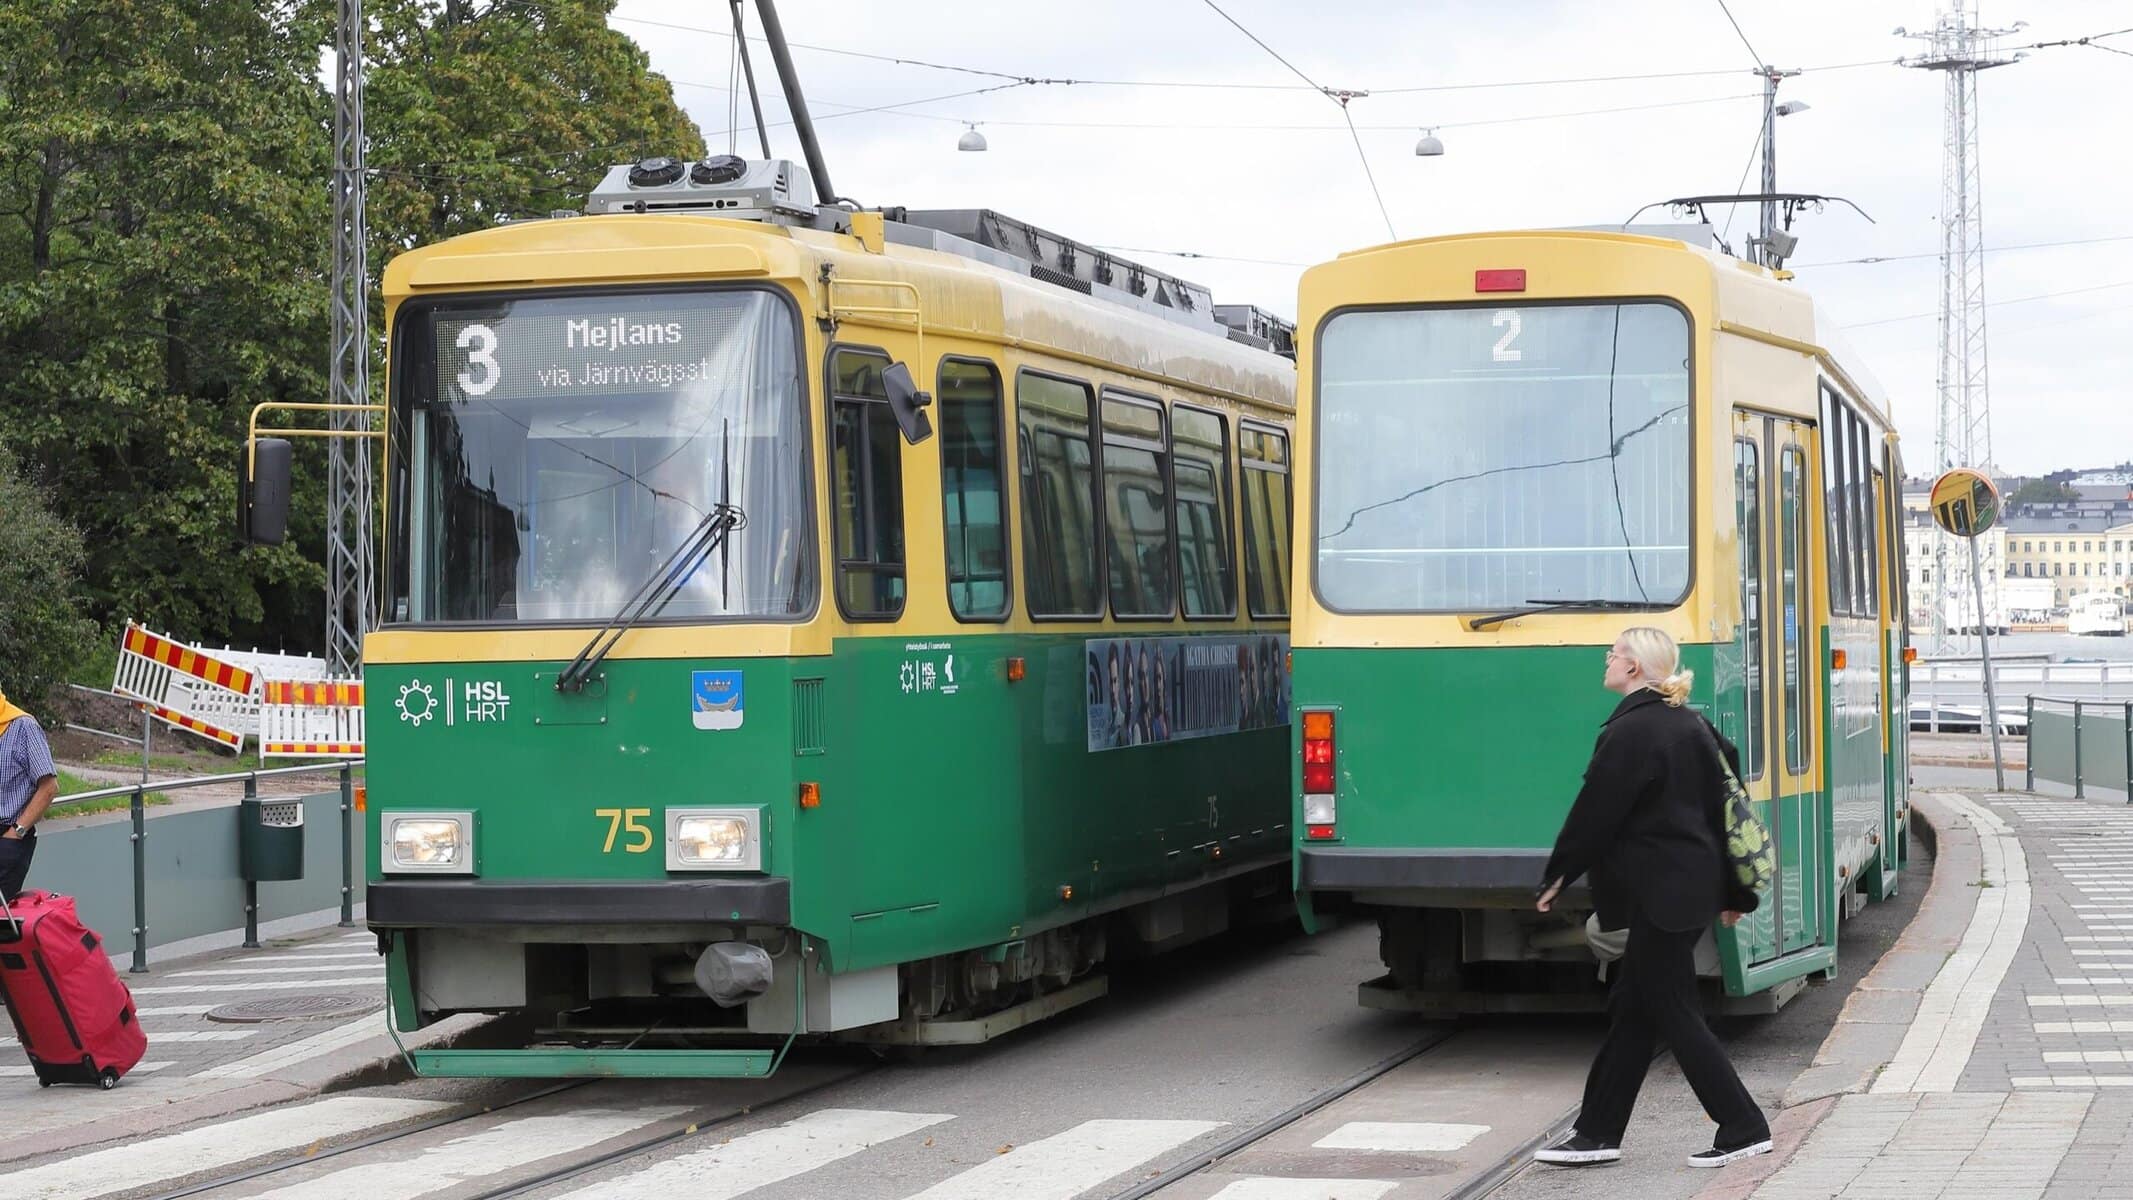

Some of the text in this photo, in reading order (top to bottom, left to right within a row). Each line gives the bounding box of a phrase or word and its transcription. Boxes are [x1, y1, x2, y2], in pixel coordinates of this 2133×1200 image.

[567, 317, 682, 351] Mejlans
[1493, 311, 1521, 361] 2
[456, 324, 501, 395] 3
[538, 357, 718, 387] via Järnvägsst.
[922, 662, 936, 676] HSL
[922, 676, 936, 690] HRT
[465, 681, 510, 701] HSL
[466, 701, 510, 722] HRT
[1207, 795, 1218, 829] 75
[595, 808, 653, 853] 75
